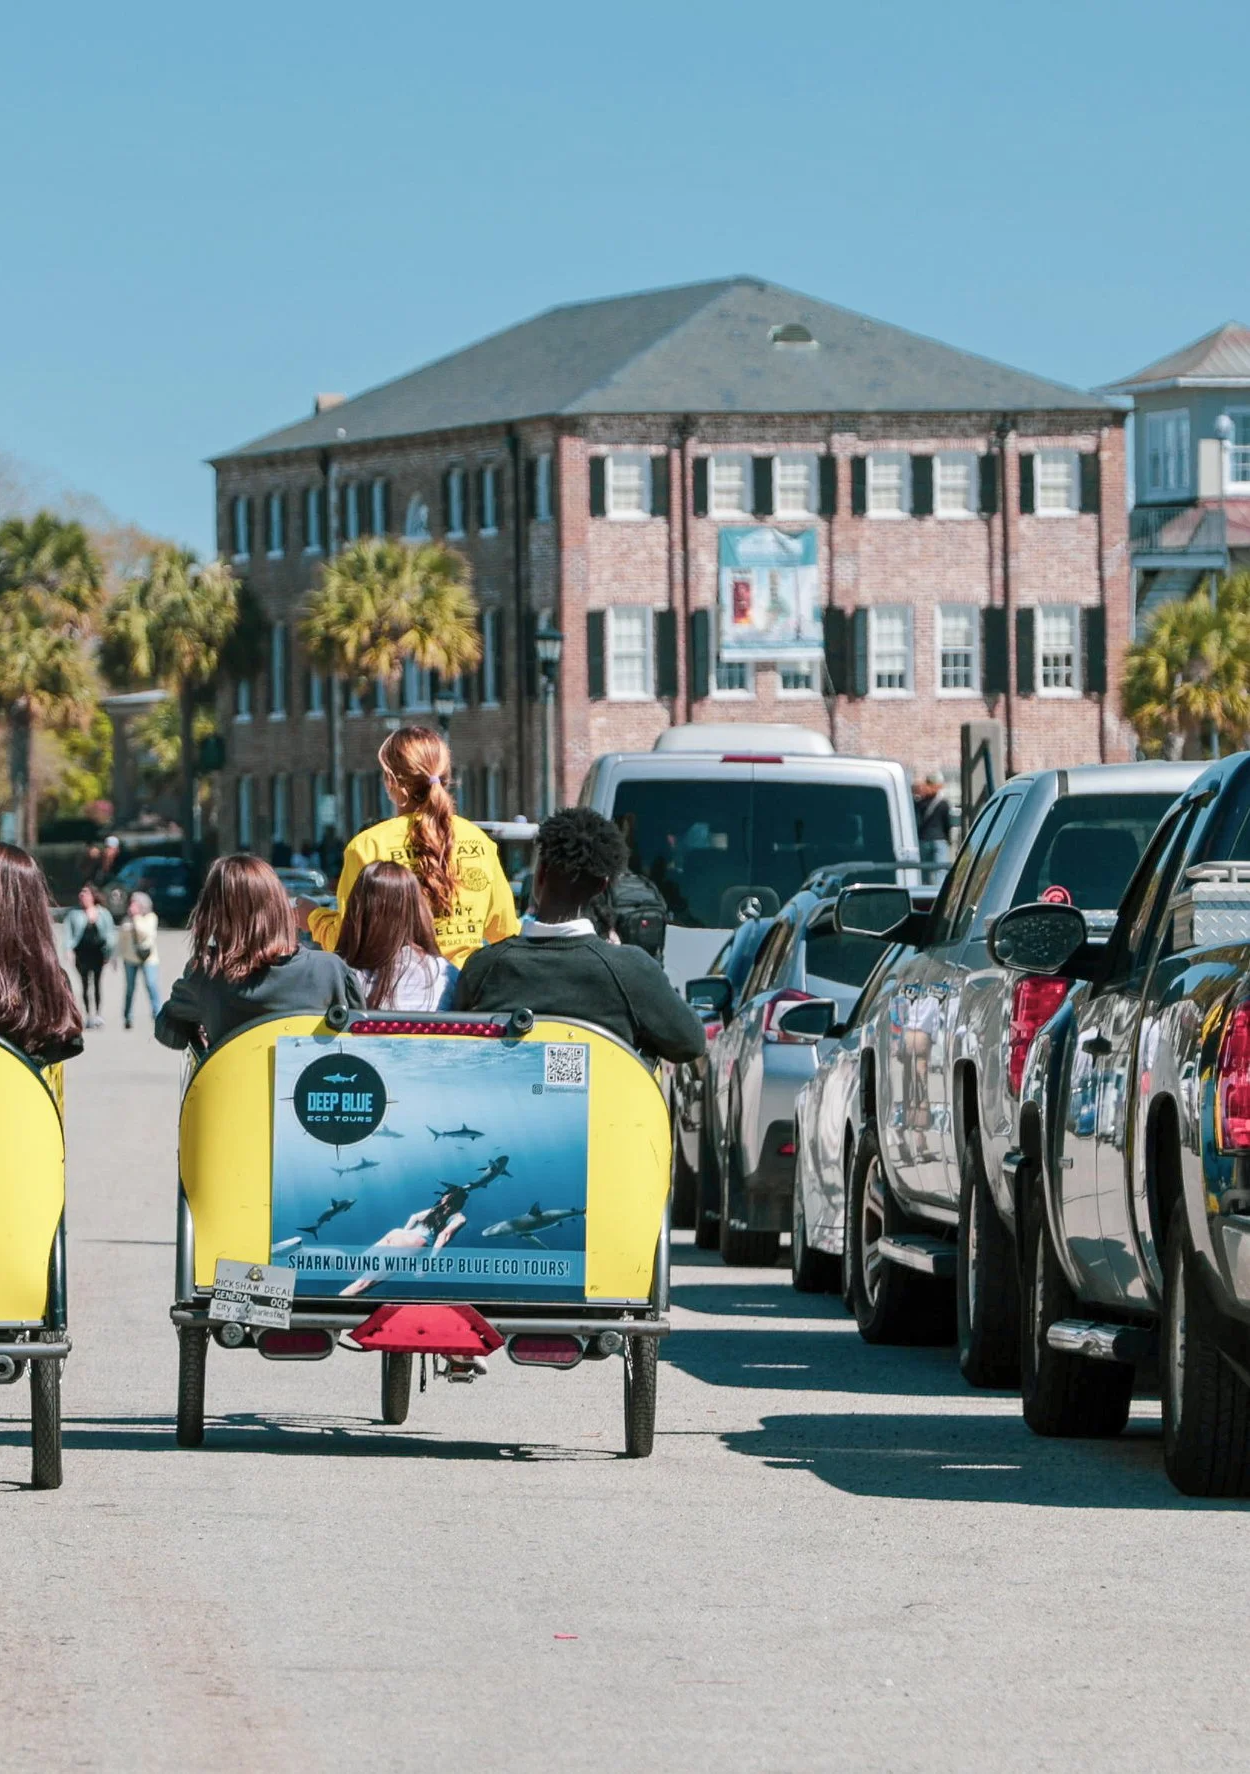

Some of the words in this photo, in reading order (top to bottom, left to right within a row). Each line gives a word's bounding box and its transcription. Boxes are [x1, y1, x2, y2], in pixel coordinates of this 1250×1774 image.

[456, 845, 486, 855] AXI
[307, 1092, 339, 1112] DEEP
[341, 1092, 373, 1112] BLUE
[334, 1115, 372, 1123] TOURS
[288, 1254, 331, 1271] SHARK
[335, 1255, 380, 1272] DIVING
[384, 1256, 417, 1273] WITH
[421, 1257, 454, 1273] DEEP
[458, 1258, 490, 1274] BLUE
[494, 1259, 519, 1275] ECO
[523, 1260, 570, 1277] TOURS!
[215, 1278, 260, 1293] RICKSHAW
[264, 1285, 292, 1297] DECAL
[214, 1290, 251, 1303] GENERAL
[215, 1302, 232, 1312] City
